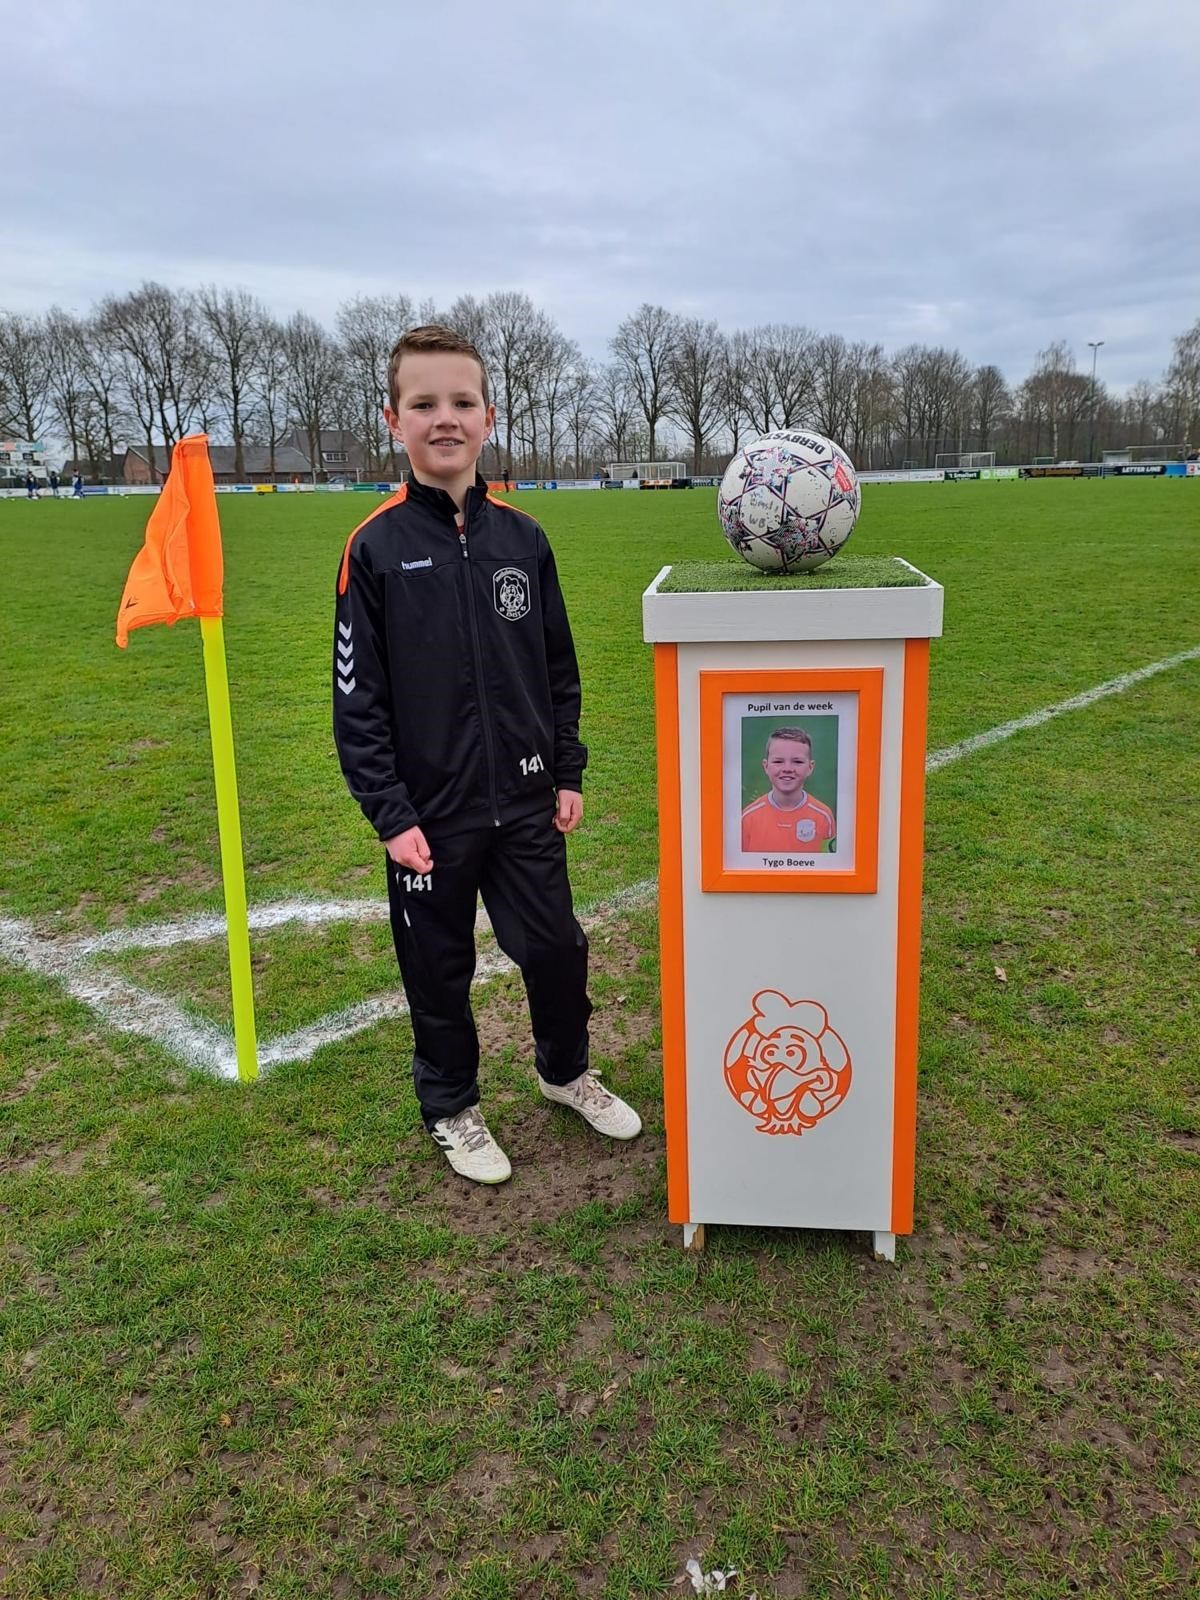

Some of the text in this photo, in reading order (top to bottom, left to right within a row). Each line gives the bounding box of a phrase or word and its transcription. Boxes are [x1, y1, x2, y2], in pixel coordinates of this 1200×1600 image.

[756, 432, 826, 455] DERBYST
[401, 556, 433, 570] hummel
[748, 703, 771, 713] Pupil
[793, 702, 805, 711] de
[808, 702, 833, 710] week
[763, 858, 815, 868] Tygo Boeve
[403, 874, 432, 892] 141
